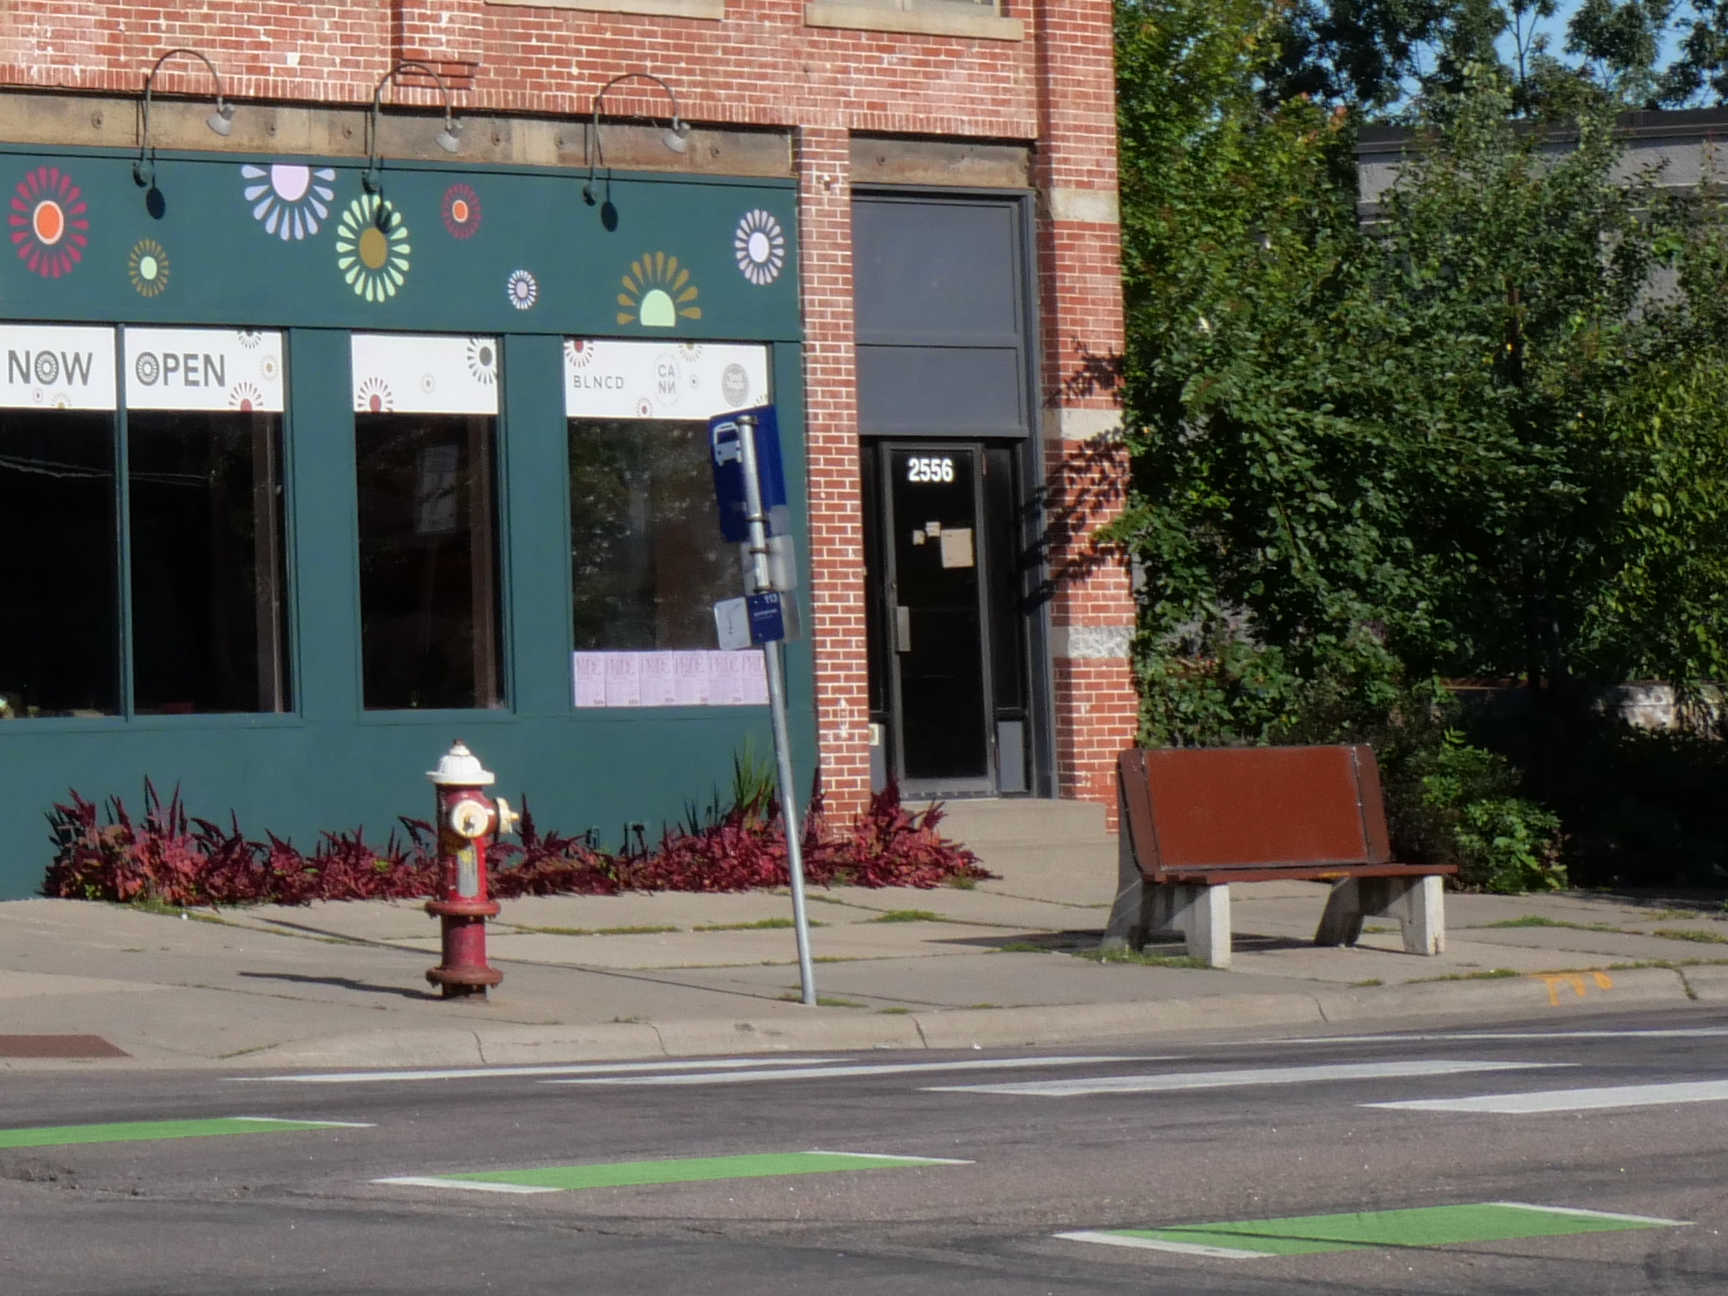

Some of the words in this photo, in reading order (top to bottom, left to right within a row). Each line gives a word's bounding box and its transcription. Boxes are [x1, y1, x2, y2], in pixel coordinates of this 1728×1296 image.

[7, 349, 93, 386] NOW
[135, 351, 226, 387] OPEN
[574, 375, 624, 389] BLNCD
[908, 458, 954, 482] 2556
